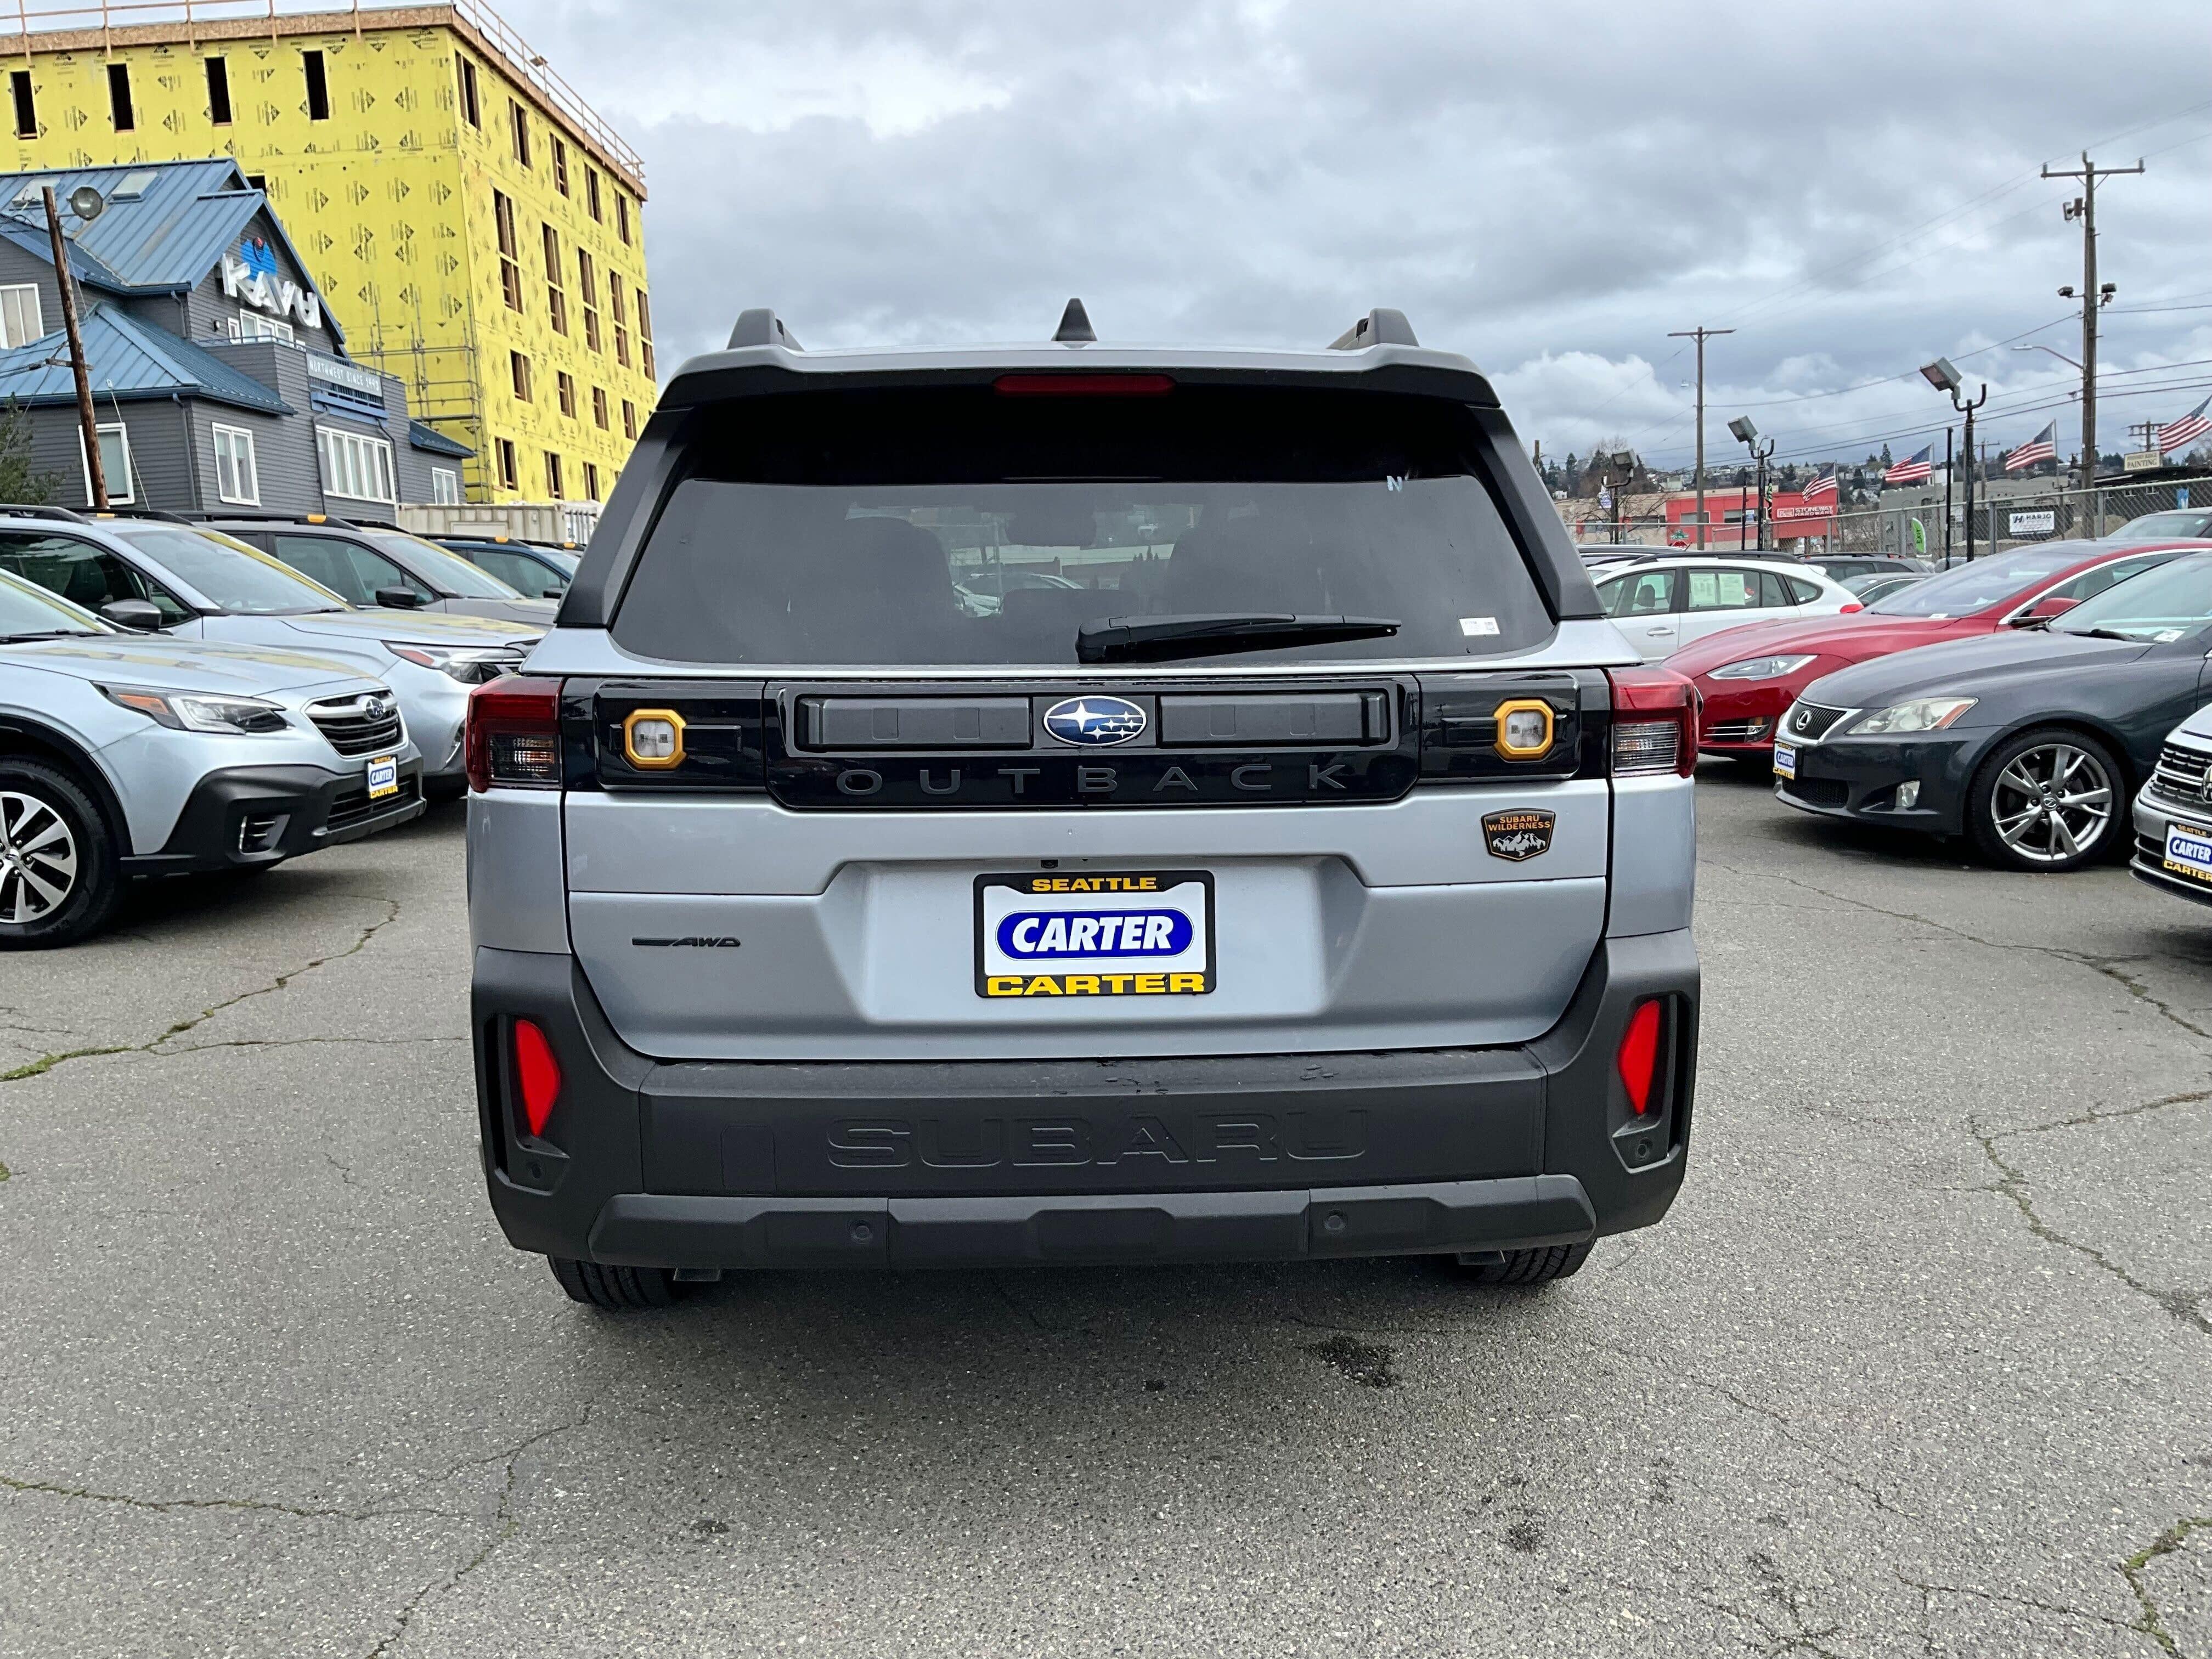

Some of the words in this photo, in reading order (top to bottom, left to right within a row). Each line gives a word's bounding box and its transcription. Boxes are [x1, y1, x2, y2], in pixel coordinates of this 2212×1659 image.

[221, 253, 321, 328] KAVU
[309, 359, 343, 379] NORTHWEST
[346, 371, 363, 385] SINCE
[2127, 459, 2157, 469] PAINTING
[1777, 752, 1794, 767] CARTER
[371, 768, 393, 785] CARTER
[836, 763, 1347, 795] OUTBACK
[1773, 768, 1795, 780] CARTER
[370, 785, 398, 799] CARTER
[1488, 821, 1551, 831] WILDERNESS
[1499, 815, 1539, 823] SUBARU
[2177, 824, 2207, 837] SEATTLE
[2172, 839, 2211, 862] CARTER
[1032, 877, 1157, 891] SEATTLE
[672, 936, 741, 947] AWD
[1012, 915, 1174, 953] CARTER
[987, 974, 1205, 996] CARTER
[826, 1108, 1369, 1168] SUBARU
